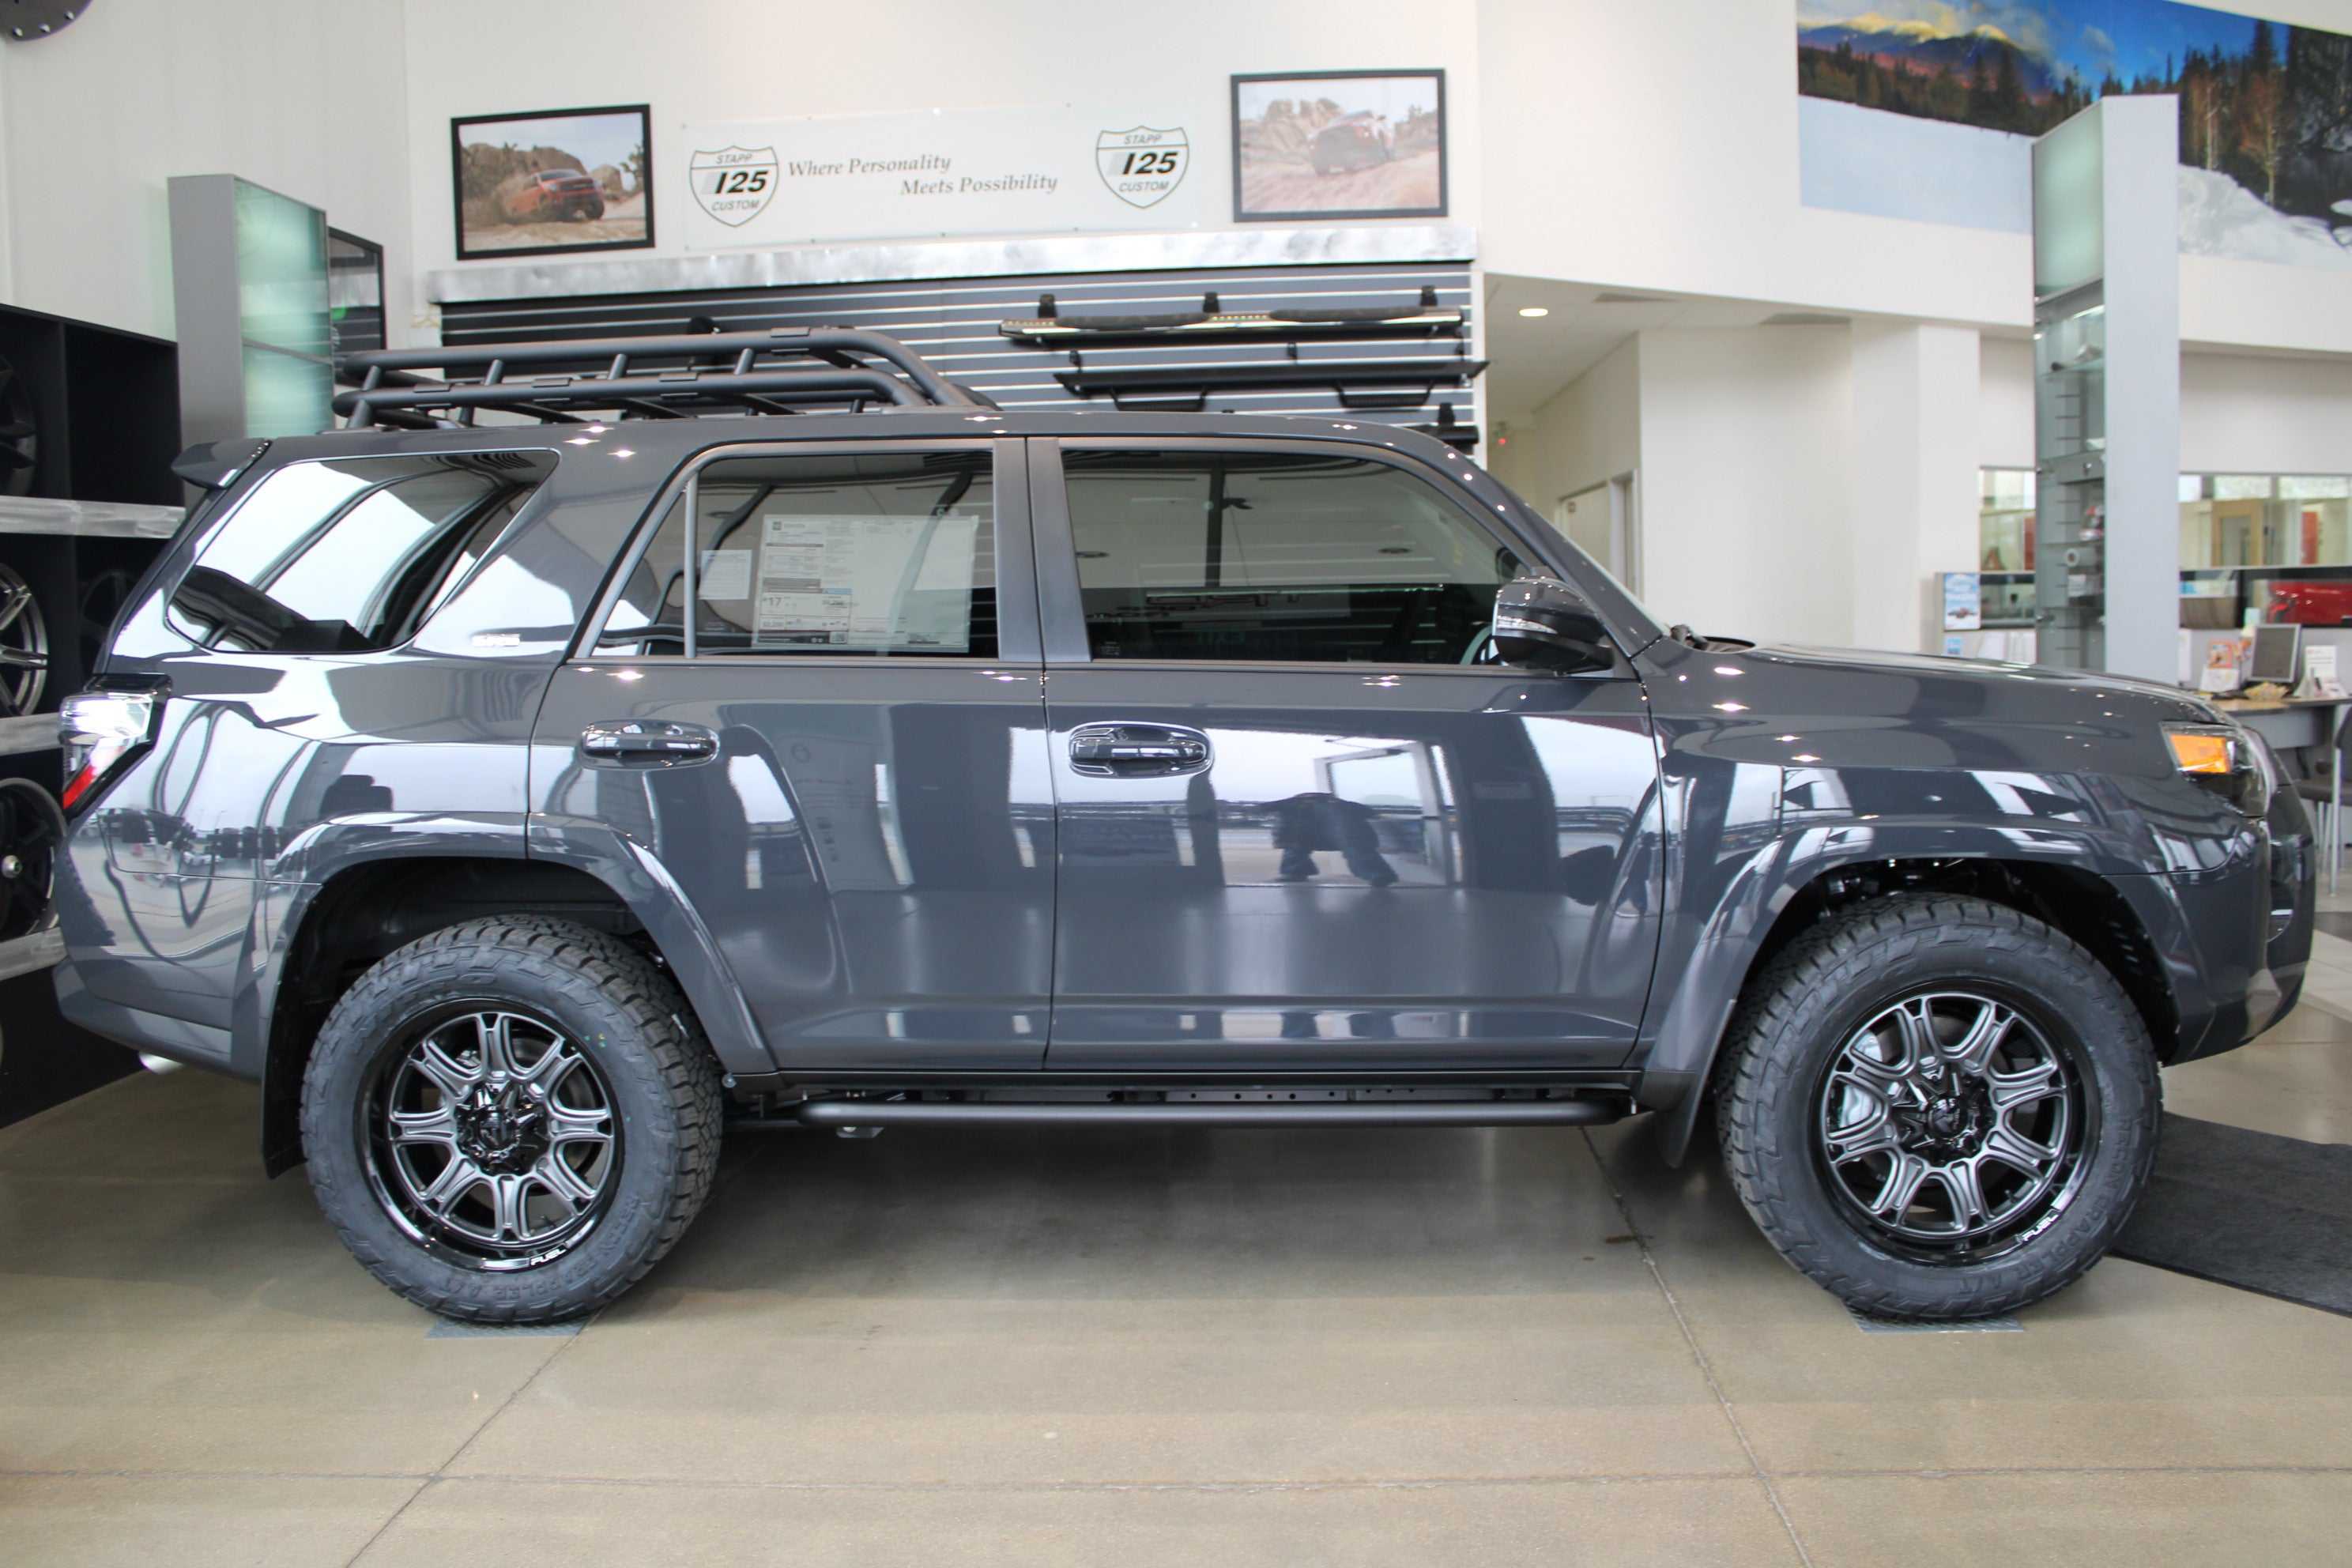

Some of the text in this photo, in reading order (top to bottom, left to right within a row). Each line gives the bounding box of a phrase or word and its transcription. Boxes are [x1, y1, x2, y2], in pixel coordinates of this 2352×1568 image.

[1124, 134, 1162, 145] STAPP
[716, 153, 752, 164] STAPP
[790, 154, 952, 176] Where Personality
[1122, 151, 1178, 175] 125
[715, 170, 768, 194] 125
[901, 174, 1058, 195] Meets Possibility
[1119, 181, 1169, 191] CUSTOM
[712, 200, 760, 210] CUSTOM
[2022, 1214, 2060, 1242] FUEL
[530, 1248, 567, 1265] FUEL
